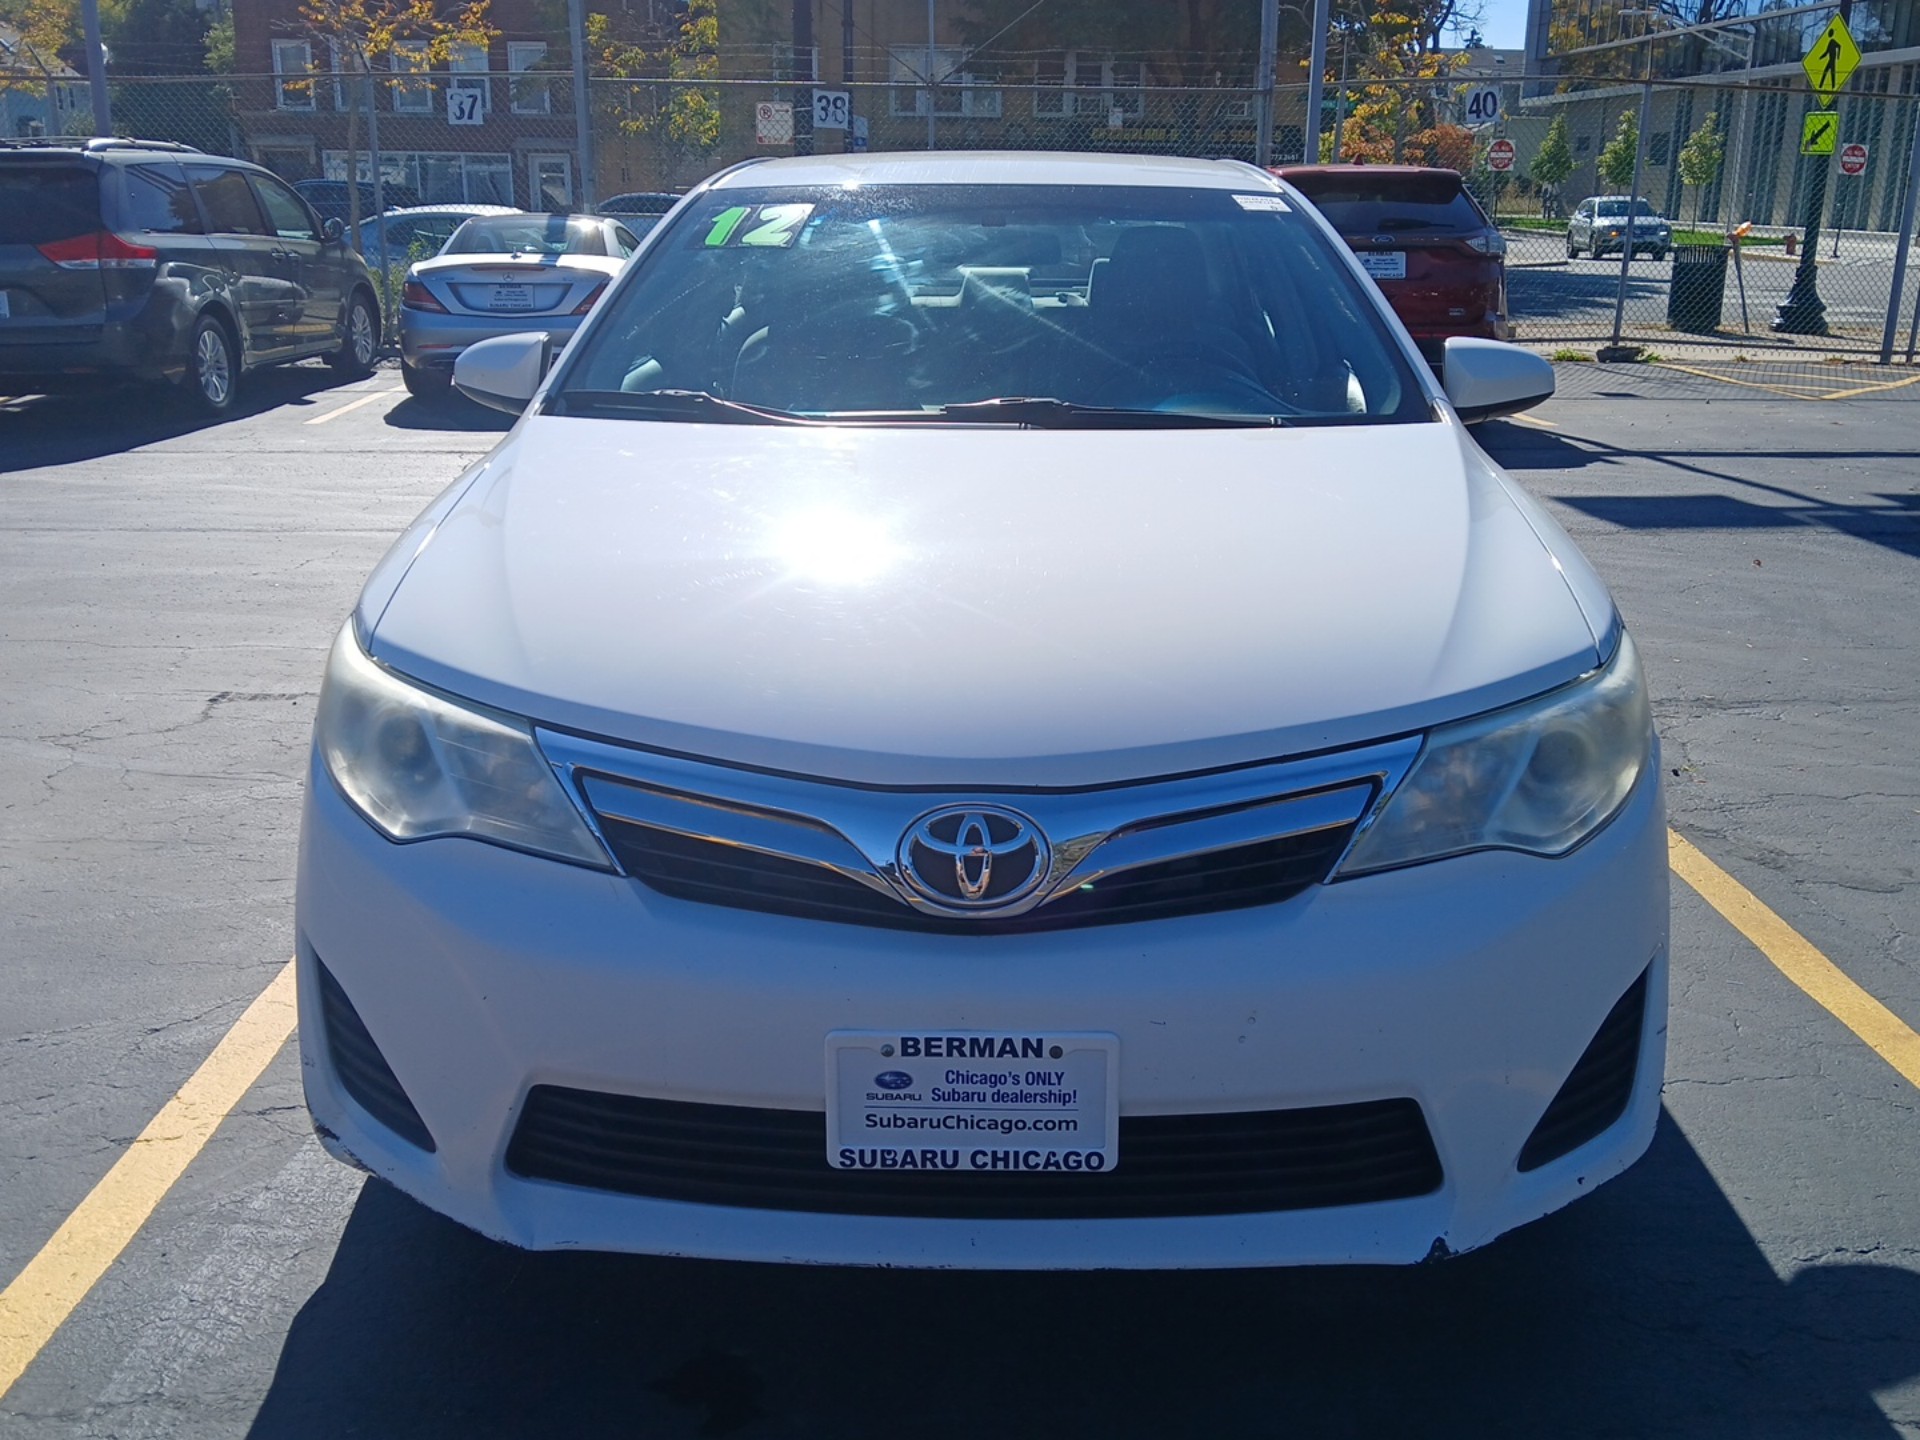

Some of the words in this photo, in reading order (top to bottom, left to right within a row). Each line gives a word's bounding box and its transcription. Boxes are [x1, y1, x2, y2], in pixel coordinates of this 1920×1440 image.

[450, 93, 478, 120] 37
[817, 95, 846, 123] 38
[1468, 91, 1497, 119] 40
[704, 203, 816, 247] 12
[900, 1037, 1044, 1058] BERMAN
[945, 1070, 1020, 1087] Chicago's
[1025, 1071, 1065, 1086] ONLY
[866, 1092, 922, 1101] SUBARU
[931, 1088, 986, 1103] Subaru
[991, 1089, 1077, 1106] dealership!
[865, 1113, 1078, 1135] SubaruChicago.com
[839, 1148, 959, 1168] SUBARU
[970, 1150, 1105, 1171] CHICAGO
